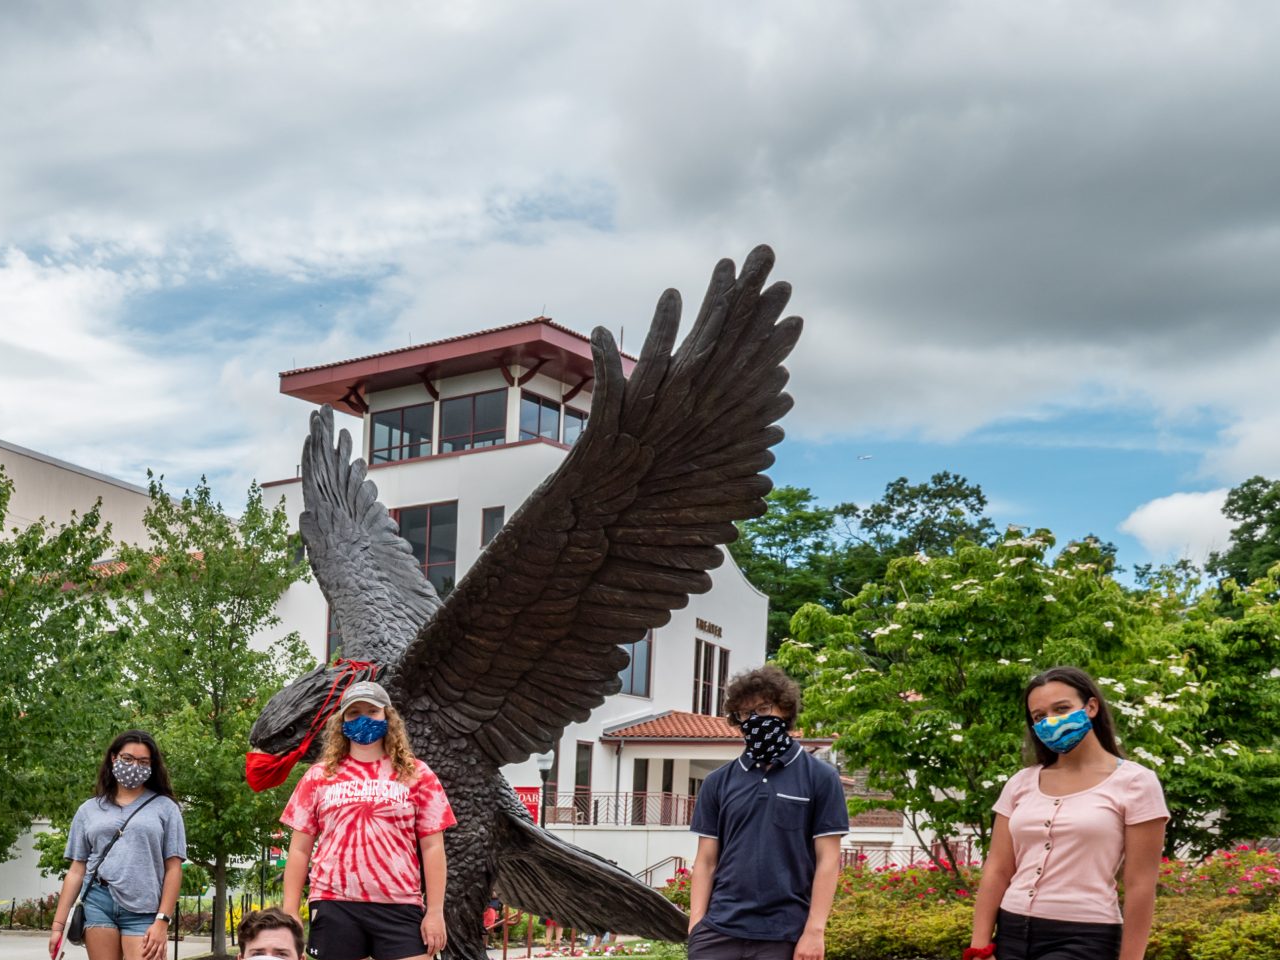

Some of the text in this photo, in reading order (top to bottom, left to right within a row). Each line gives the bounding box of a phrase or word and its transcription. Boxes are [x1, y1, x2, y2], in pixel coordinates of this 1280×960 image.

[324, 779, 378, 807] MONTCLAIR
[518, 793, 539, 803] OAR
[336, 796, 396, 808] UNIVERSITY
